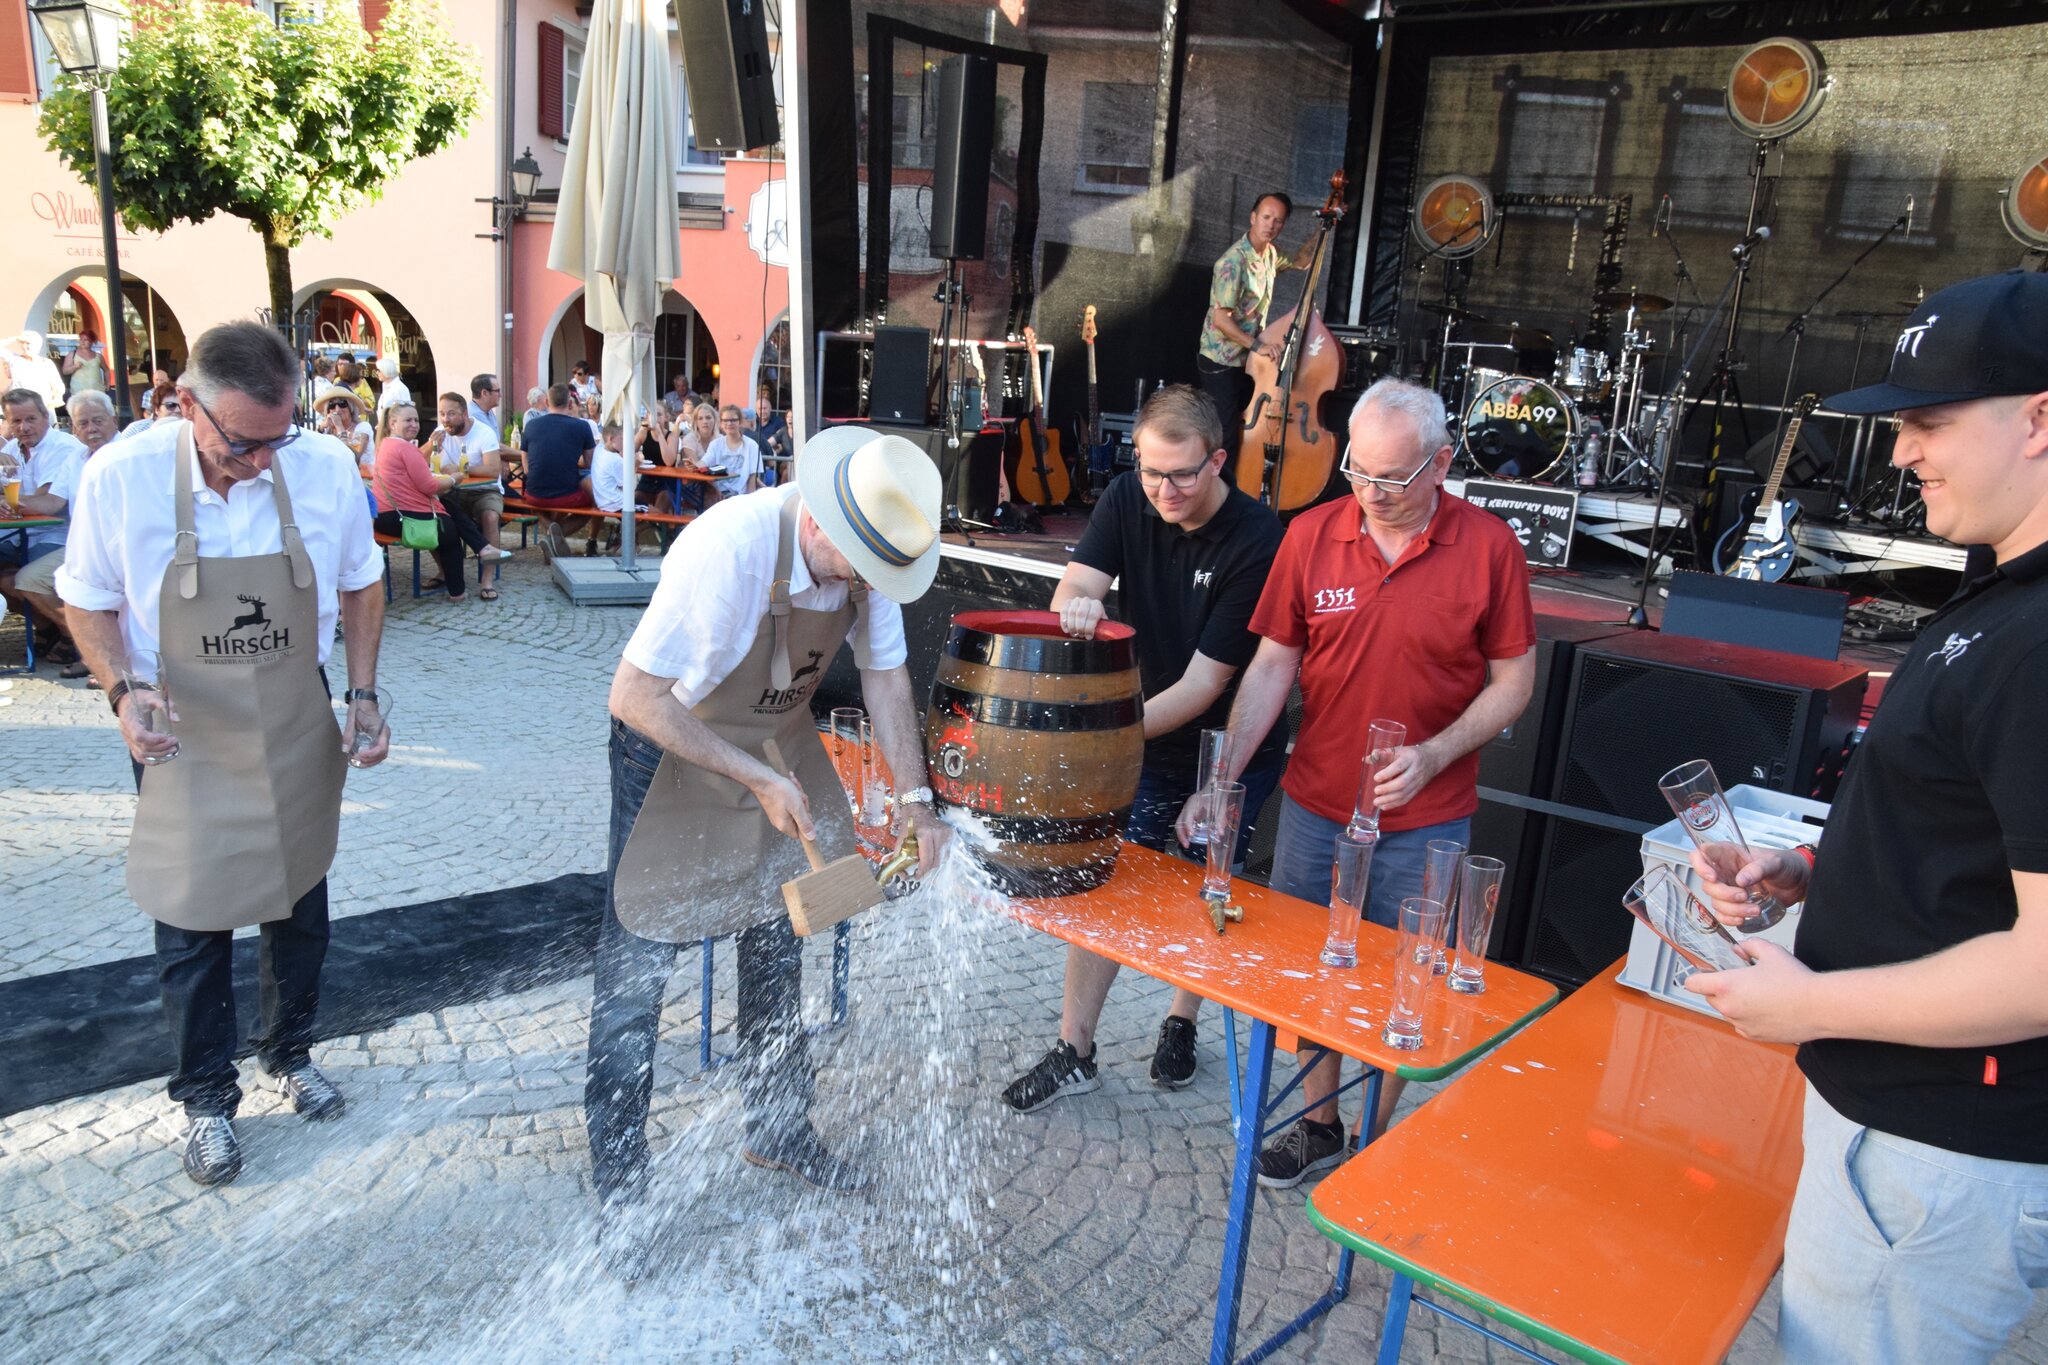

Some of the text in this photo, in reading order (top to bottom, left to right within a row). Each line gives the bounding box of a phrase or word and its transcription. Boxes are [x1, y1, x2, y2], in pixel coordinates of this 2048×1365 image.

[66, 246, 93, 257] CAFÉ
[1479, 400, 1557, 424] ABBA99
[1467, 495, 1570, 520] THE KENTUCKY BOYS
[1314, 587, 1356, 607] 1351
[202, 628, 289, 654] HIRSCH
